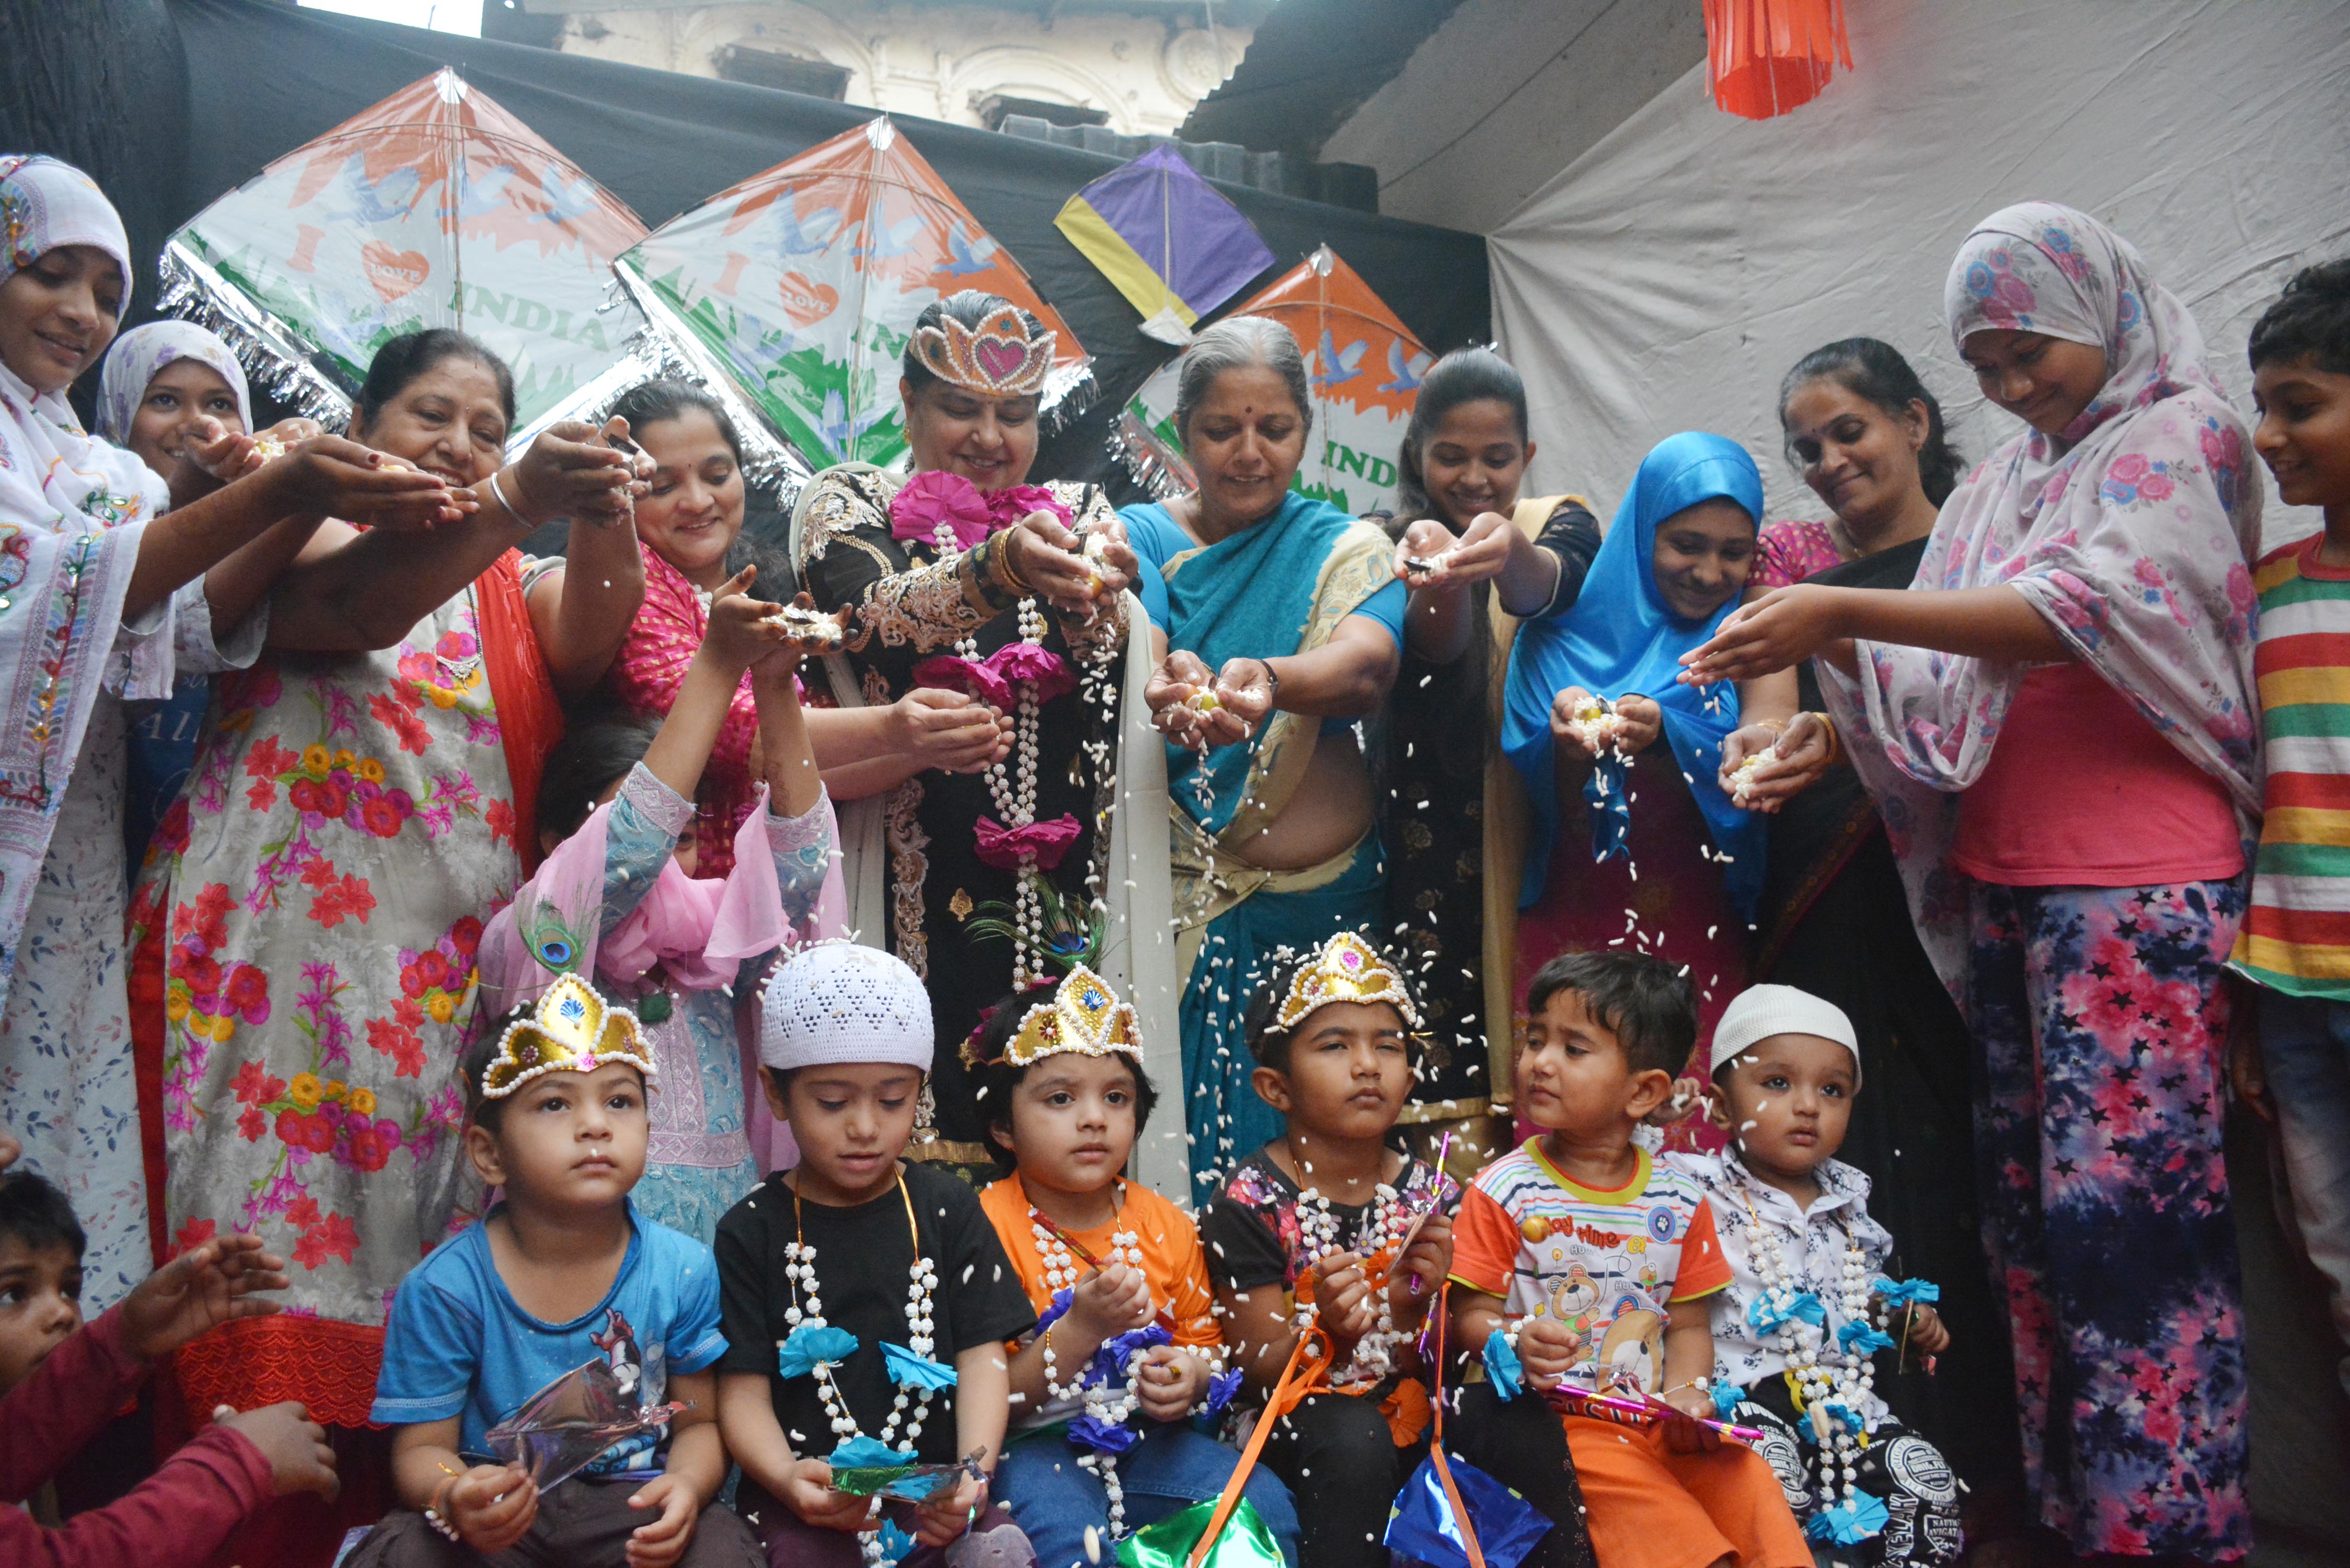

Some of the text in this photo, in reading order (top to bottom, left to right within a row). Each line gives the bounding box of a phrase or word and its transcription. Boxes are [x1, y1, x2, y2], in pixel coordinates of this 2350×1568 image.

[370, 262, 423, 284] LOVE
[447, 281, 610, 352] INDIA
[784, 292, 830, 314] LOVE
[1576, 1224, 1621, 1250] time
